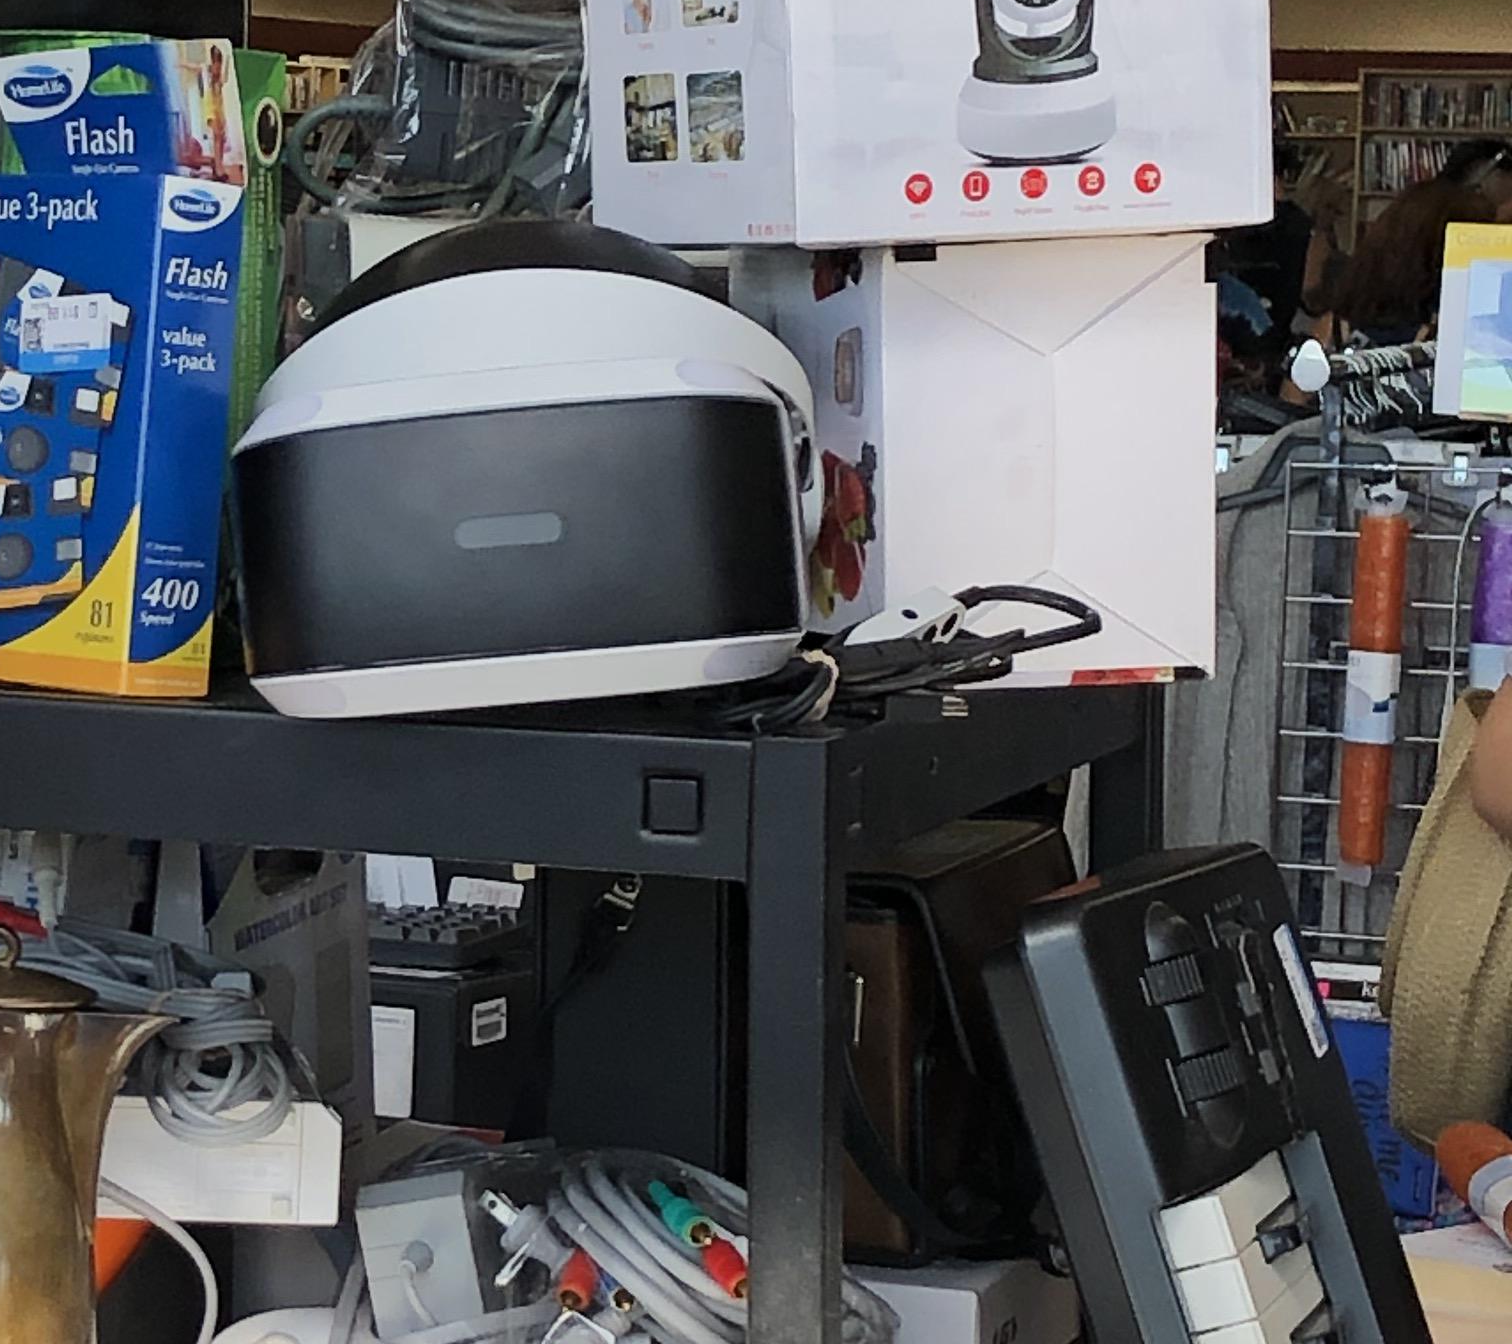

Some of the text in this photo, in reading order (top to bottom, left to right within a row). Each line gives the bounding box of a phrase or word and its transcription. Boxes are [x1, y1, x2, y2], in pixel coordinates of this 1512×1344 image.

[64, 115, 135, 155] Flash
[26, 188, 98, 230] 3-pack
[165, 256, 228, 291] Flash
[162, 325, 207, 348] value
[160, 349, 216, 375] 3-pack
[141, 577, 199, 611] 400
[90, 599, 113, 628] 81
[140, 610, 175, 626] Speed
